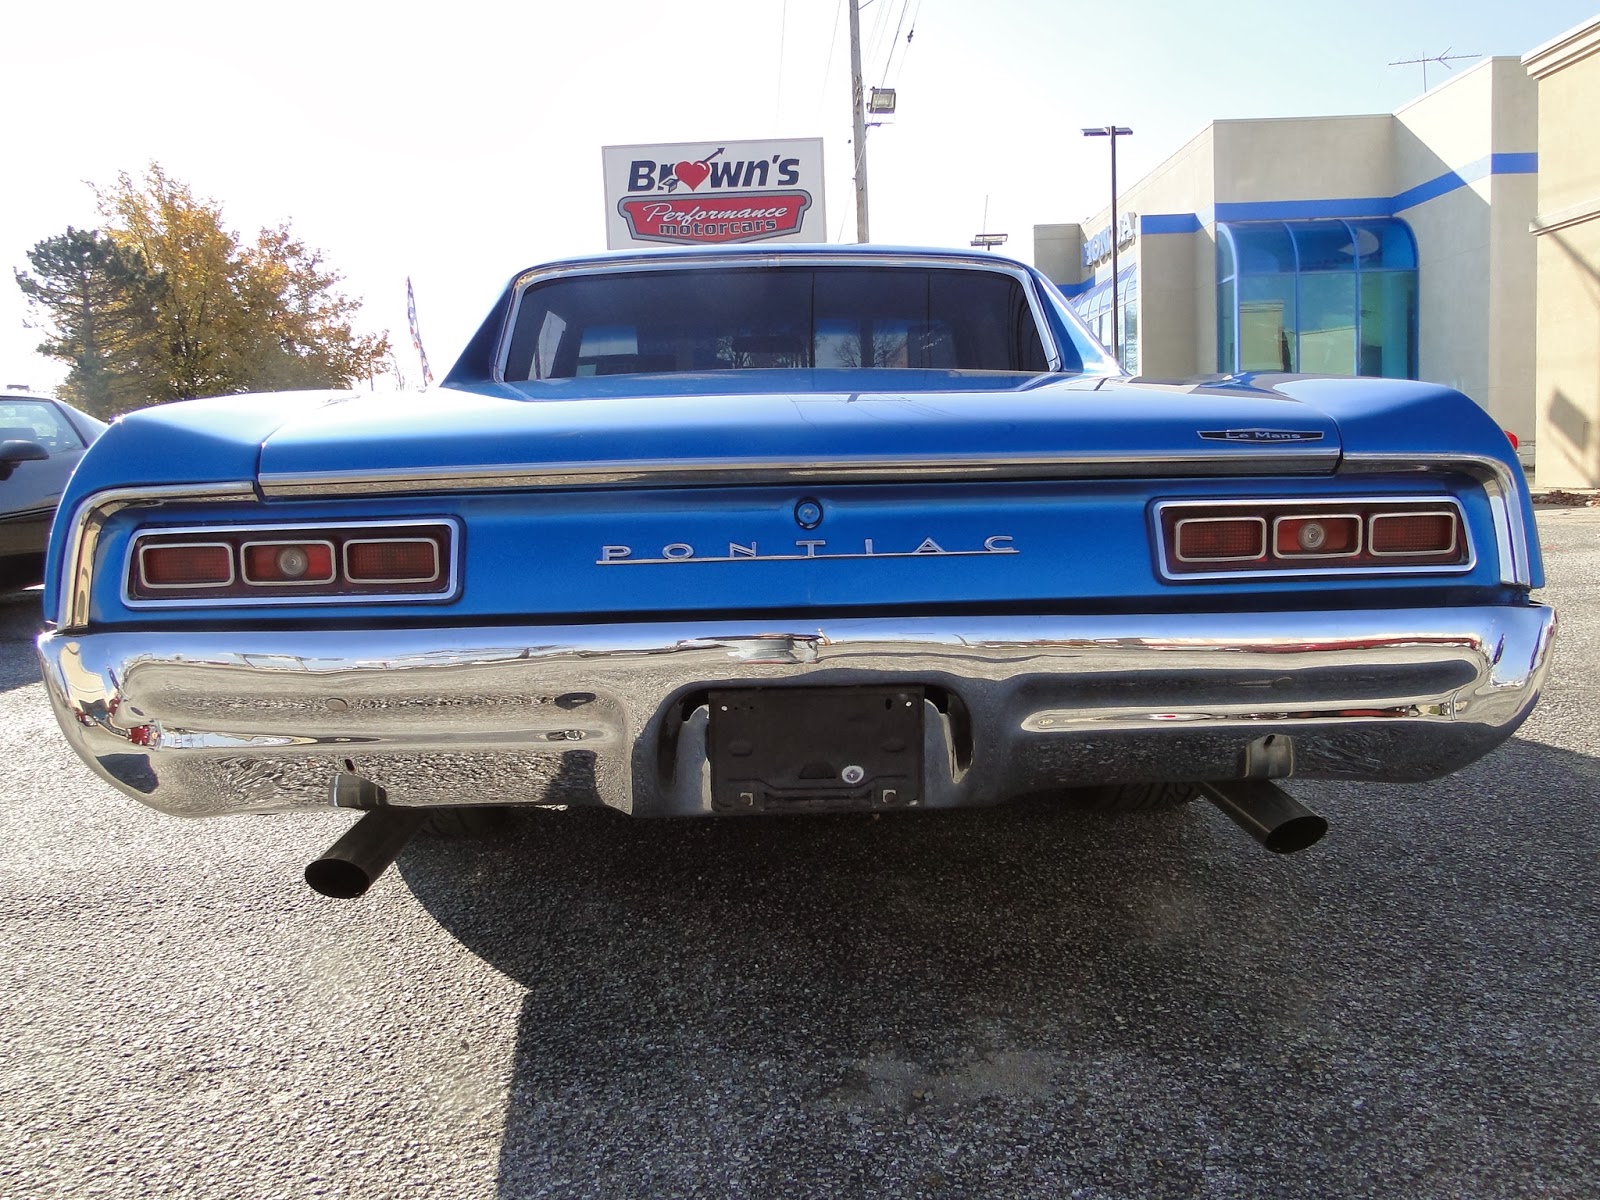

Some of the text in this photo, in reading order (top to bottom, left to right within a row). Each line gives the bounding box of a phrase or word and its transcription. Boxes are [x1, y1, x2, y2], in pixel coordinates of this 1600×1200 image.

[643, 202, 788, 226] Performance
[659, 219, 777, 236] motorcars
[1083, 212, 1136, 266] HONA
[1225, 431, 1301, 439] Le Mans
[602, 535, 1015, 562] PONTIAC
